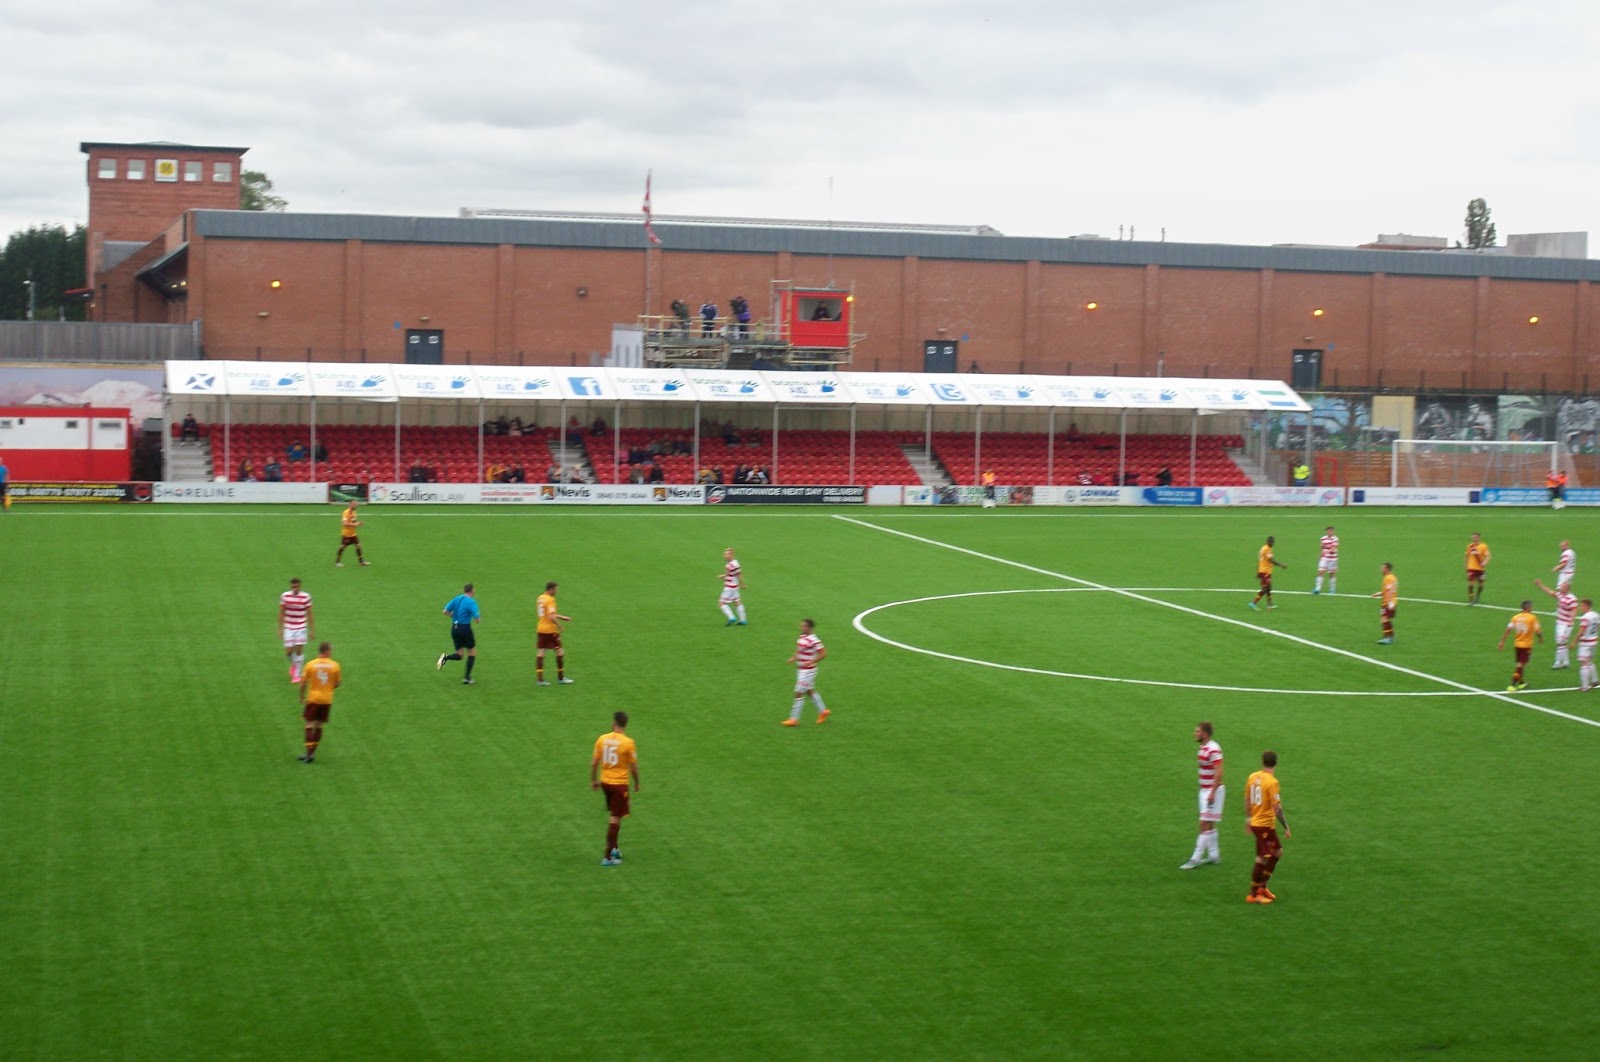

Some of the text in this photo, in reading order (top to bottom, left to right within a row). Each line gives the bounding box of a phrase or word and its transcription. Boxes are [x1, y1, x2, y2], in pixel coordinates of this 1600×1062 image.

[390, 486, 437, 501] Scullion
[557, 486, 591, 497] Nevis
[668, 487, 702, 498] Nevis
[727, 487, 781, 495] NATIONWIDE
[781, 487, 804, 495] NEXT
[804, 487, 823, 495] DAY
[823, 487, 865, 495] DELIVERY
[602, 744, 619, 766] 16
[1250, 784, 1263, 806] 18
